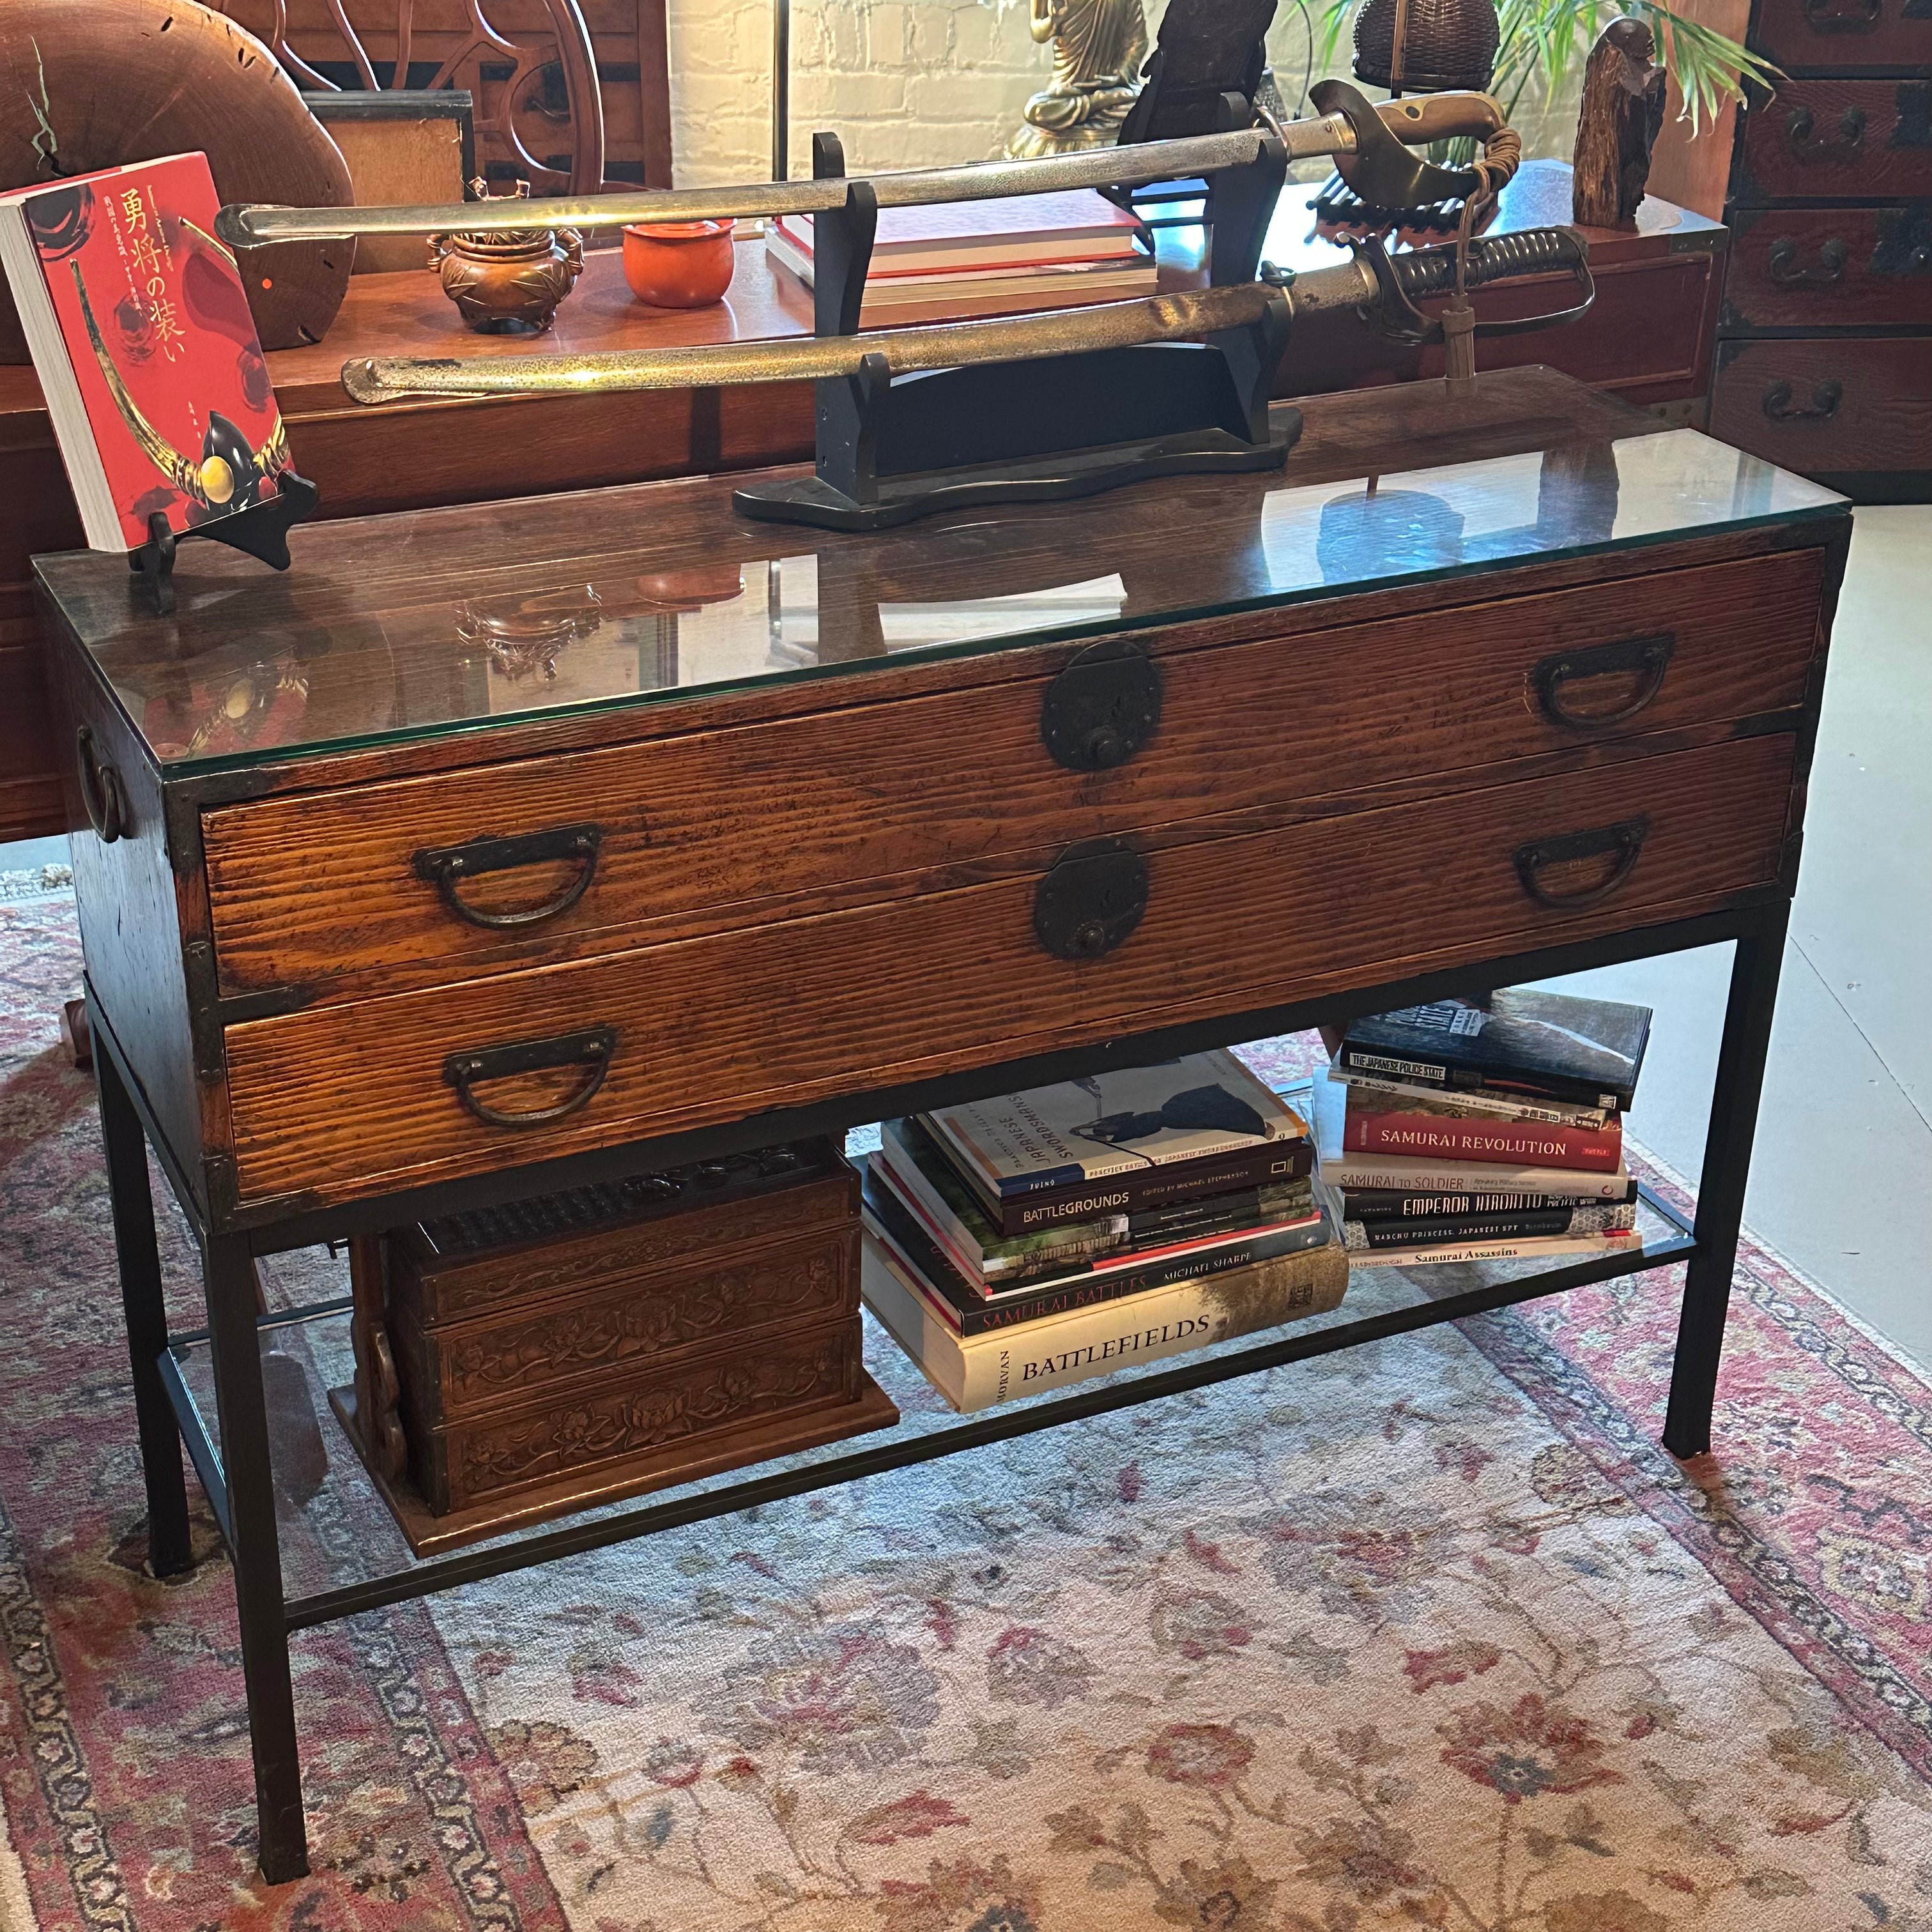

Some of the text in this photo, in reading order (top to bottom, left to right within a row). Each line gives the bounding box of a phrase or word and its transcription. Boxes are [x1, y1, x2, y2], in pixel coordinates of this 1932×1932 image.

[120, 188, 187, 363] 勇将の装い
[1353, 1055, 1444, 1078] THE JAPANESE POLICE STATE
[999, 1117, 1052, 1165] JAPANESE
[1381, 1130, 1456, 1147] SAMURAI
[1462, 1136, 1567, 1155] REVOLUTION
[1340, 1174, 1395, 1188] SAMURAI
[1399, 1179, 1411, 1189] TO
[1414, 1176, 1464, 1190] SOLDIER
[1023, 1192, 1130, 1223] BATTLEGROUNDS
[1403, 1196, 1469, 1216] EMPEROR
[1476, 1193, 1542, 1212] HIROHITO
[1375, 1232, 1409, 1241] MANCHU
[1459, 1226, 1499, 1235] JAPANESE
[1164, 1252, 1251, 1280] MICHAEL SHARPE
[1415, 1248, 1518, 1264] Samurai Assassins
[983, 1275, 1147, 1328] SAMURAI BATTLES
[1022, 1314, 1210, 1381] BATTLEFIELDS
